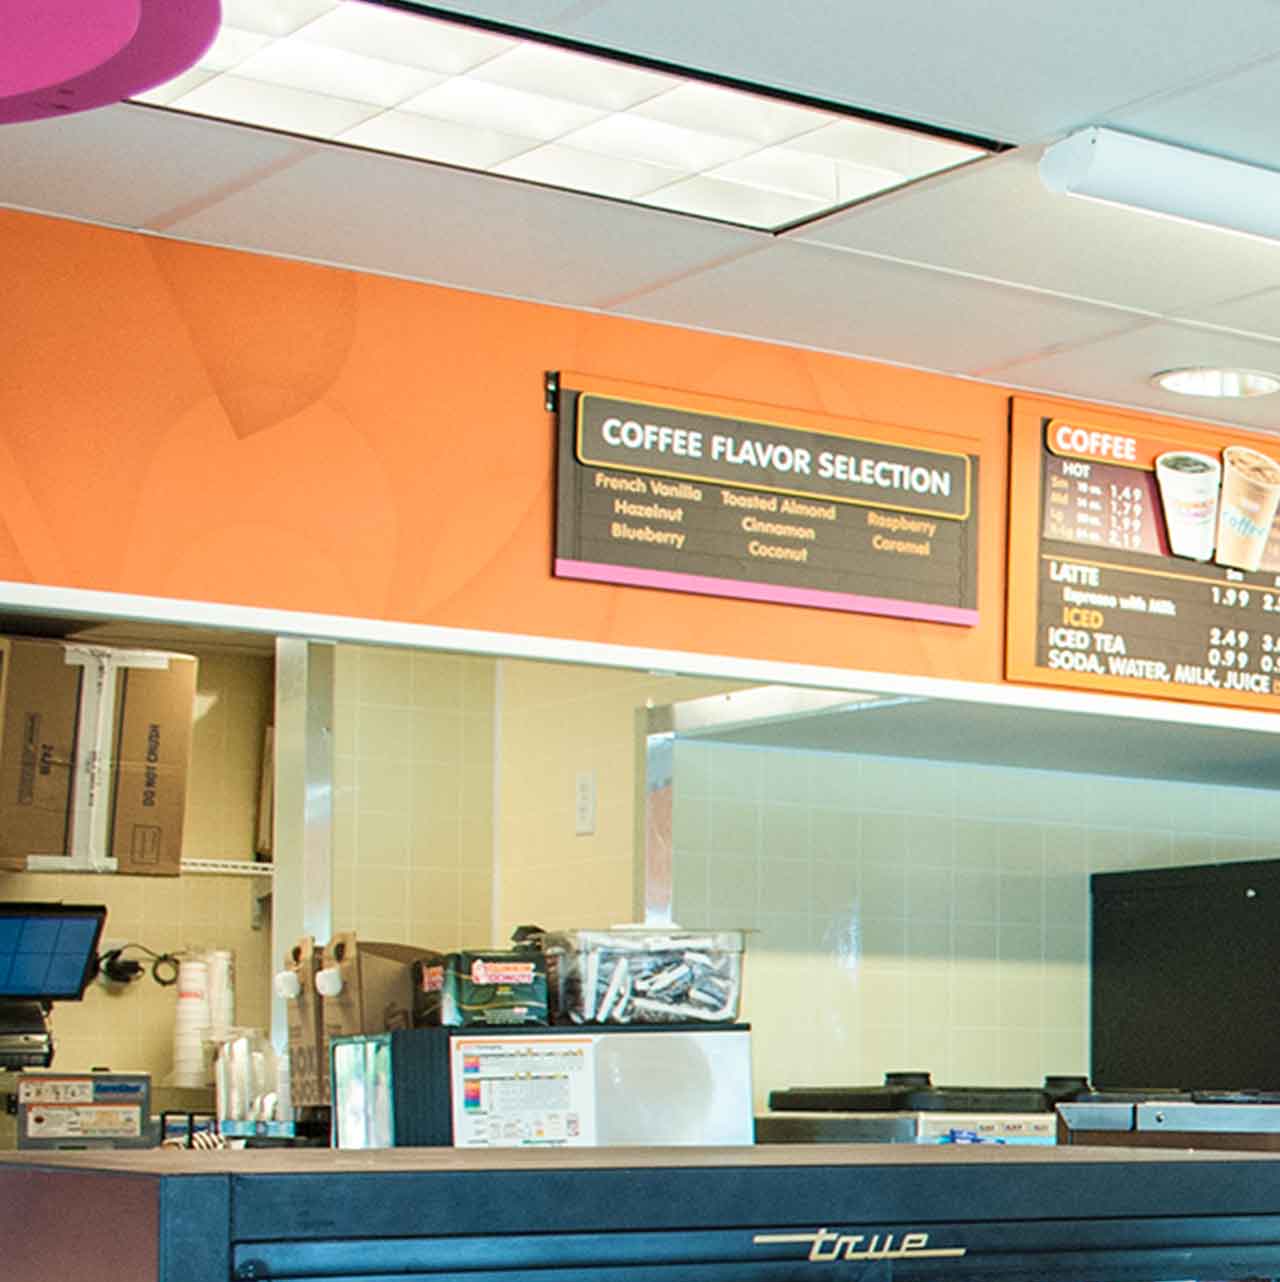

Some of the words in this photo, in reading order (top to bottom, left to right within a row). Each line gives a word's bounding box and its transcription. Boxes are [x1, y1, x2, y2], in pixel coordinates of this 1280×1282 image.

[1056, 426, 1137, 461] COFFEE
[602, 419, 703, 458] COFFEE
[711, 435, 811, 475] FLAVOR
[818, 452, 952, 497] SELECTION
[1062, 461, 1091, 478] HOT
[595, 473, 647, 494] French
[650, 480, 703, 501] Vanilla
[614, 499, 683, 522] Hazelnut
[721, 490, 777, 513] Toasted
[780, 498, 837, 521] Almond
[611, 522, 685, 549] Blueberry
[742, 517, 816, 541] Cinnamon
[867, 512, 937, 537] Raspberry
[748, 541, 808, 563] Coconut
[872, 534, 931, 557] Caramel
[1050, 561, 1099, 587] LATTE
[1211, 587, 1250, 608] 1.99
[1063, 607, 1104, 629] ICED
[1048, 627, 1091, 651] ICED
[1095, 634, 1127, 656] TEA
[1210, 628, 1249, 648] 2.49
[1208, 649, 1248, 669] 0.99
[1048, 650, 1106, 676] SODA,
[1109, 656, 1171, 683] WATER,
[1175, 666, 1220, 690] MILK,
[1224, 671, 1271, 695] JUICE
[753, 1227, 966, 1262] true
